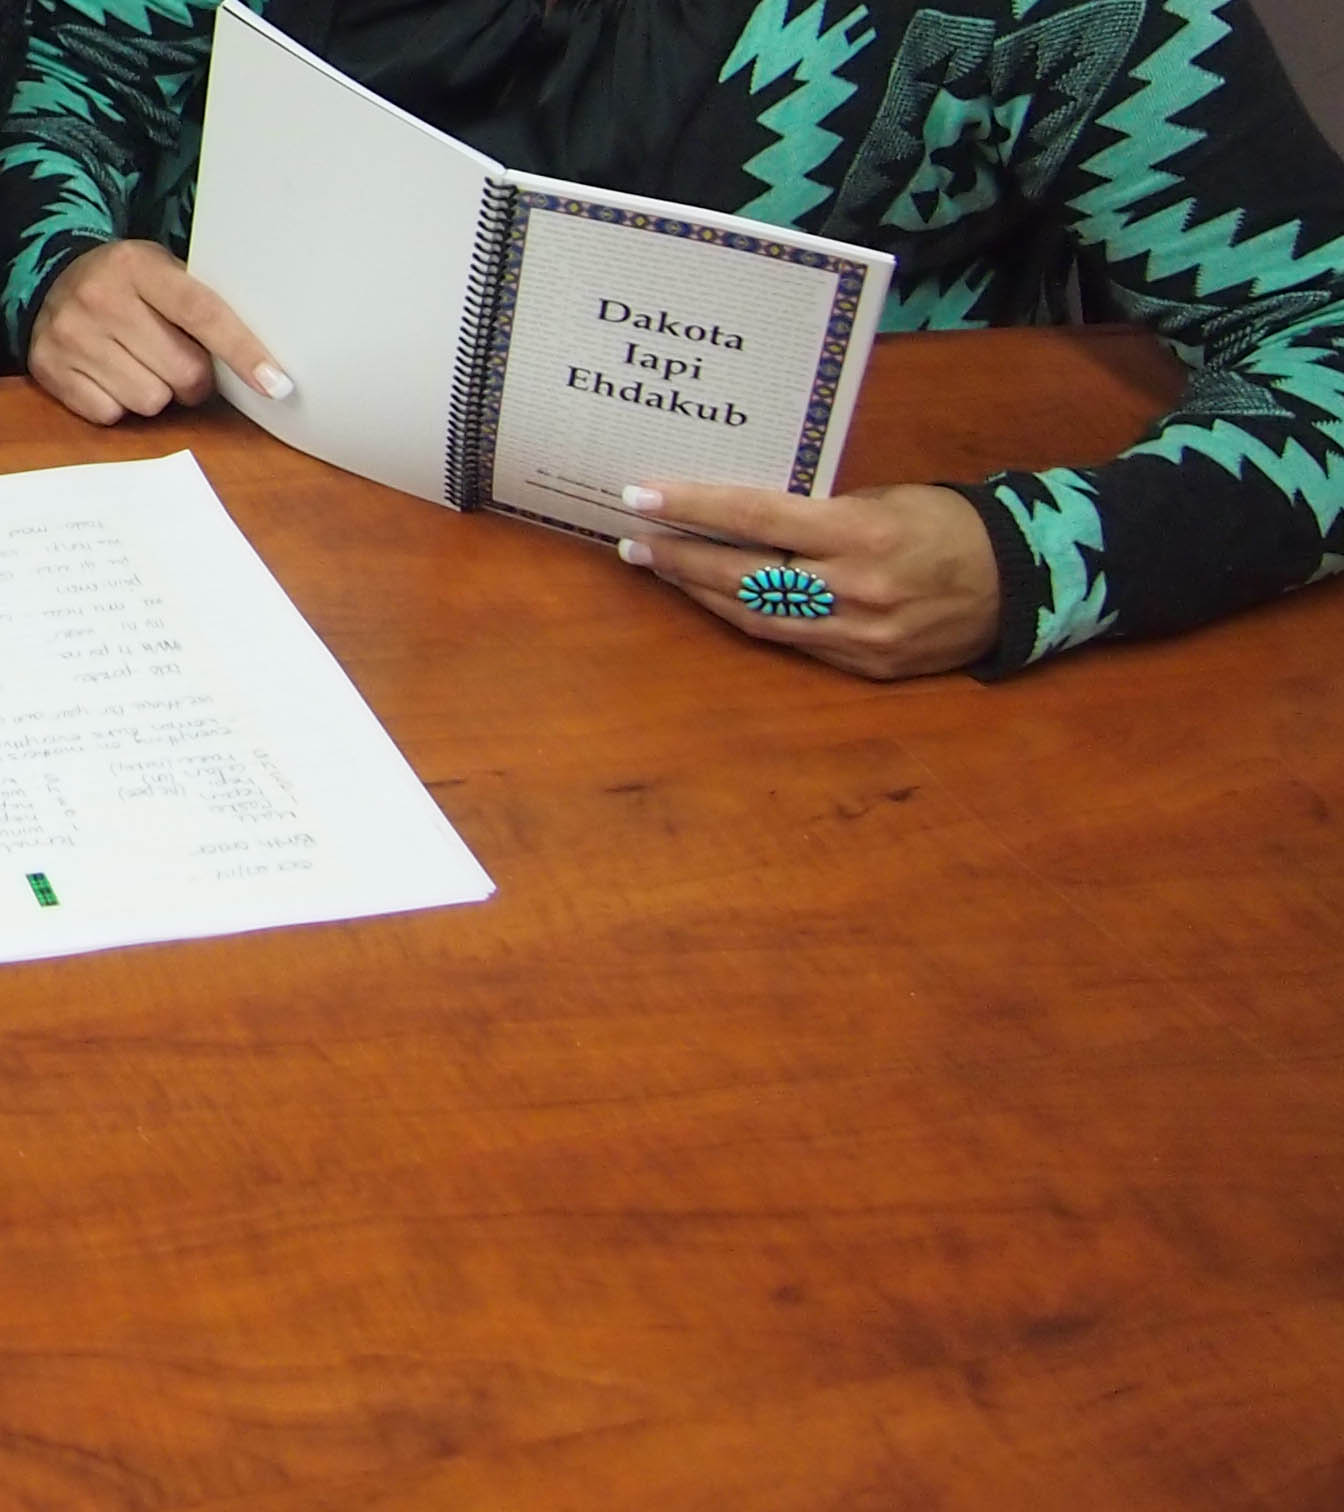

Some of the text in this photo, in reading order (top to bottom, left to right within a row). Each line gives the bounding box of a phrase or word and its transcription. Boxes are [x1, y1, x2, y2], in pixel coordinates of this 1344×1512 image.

[598, 297, 744, 352] Dakota
[623, 342, 703, 381] Iapi
[567, 365, 748, 428] Ehdakub
